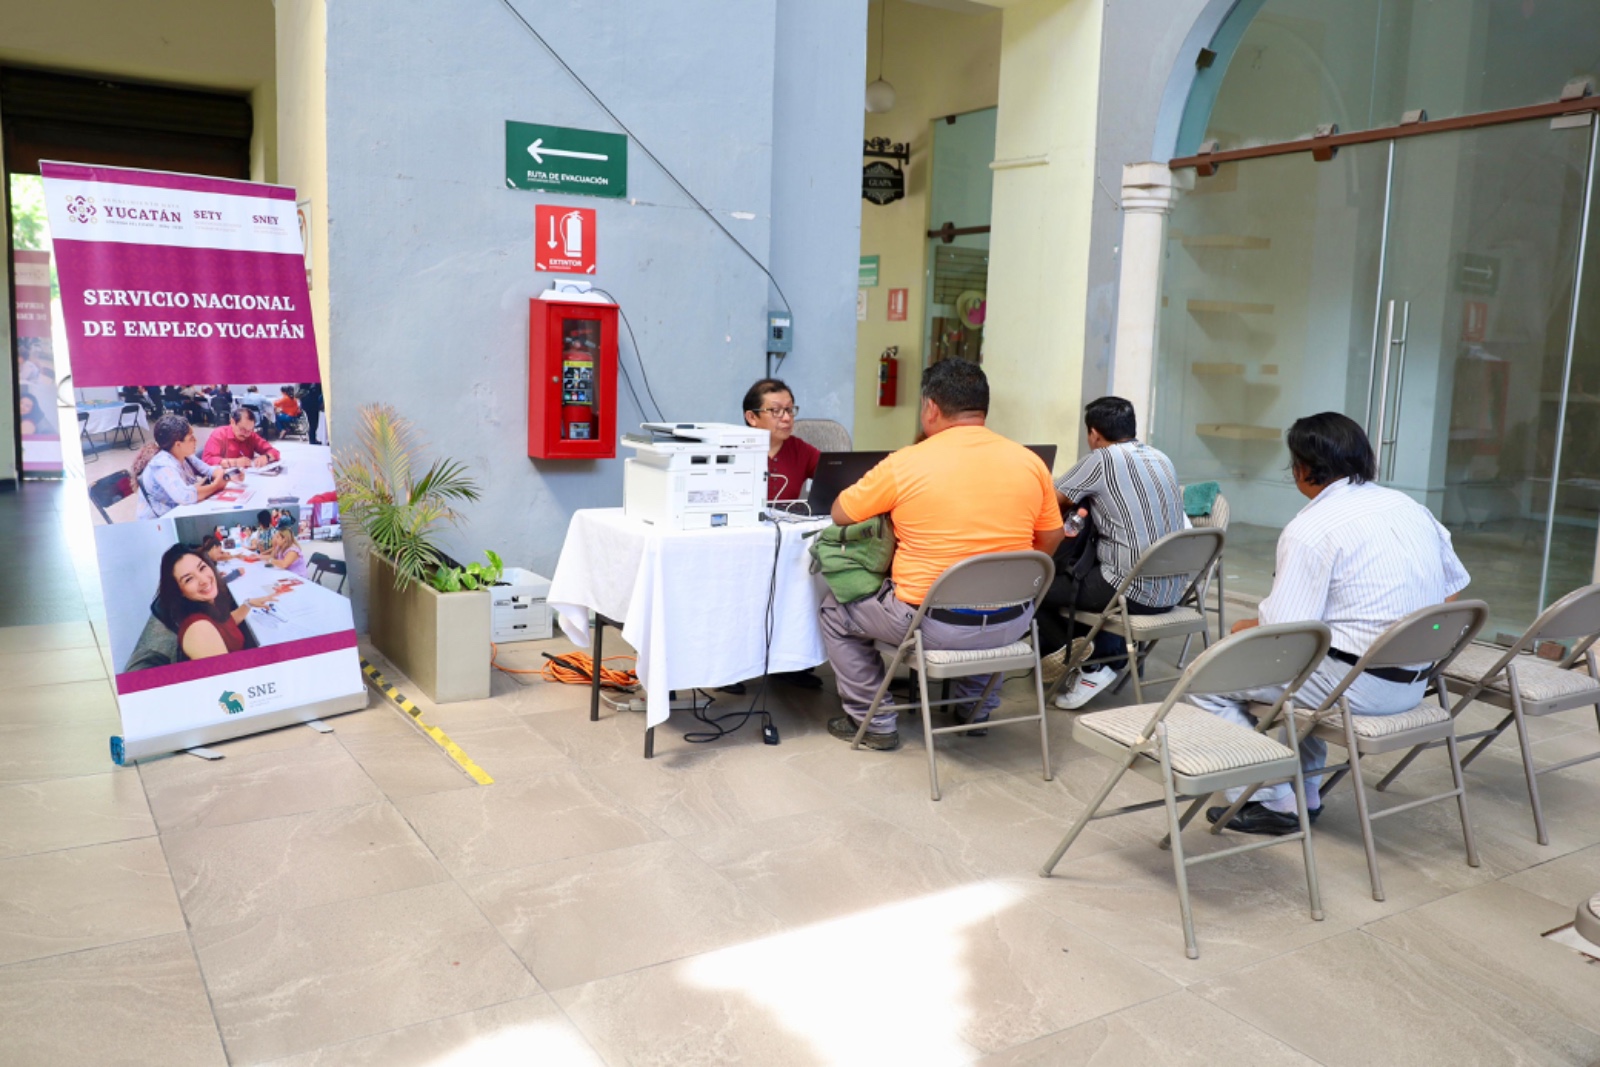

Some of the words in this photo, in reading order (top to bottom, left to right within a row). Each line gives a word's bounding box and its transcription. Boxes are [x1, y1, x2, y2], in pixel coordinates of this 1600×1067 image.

[527, 170, 546, 179] RUTA
[561, 174, 608, 185] EVACUACIÓN
[104, 206, 181, 222] YUCATÁN
[193, 210, 222, 221] SETY
[252, 215, 279, 225] SNEY
[549, 258, 582, 266] EXTINTOR
[83, 289, 189, 308] SERVICIO
[192, 293, 295, 311] NACIONAL
[82, 320, 116, 337] DE
[123, 321, 213, 338] EMPLEO
[215, 319, 304, 339] YUCATÁN
[247, 682, 276, 698] SNE
